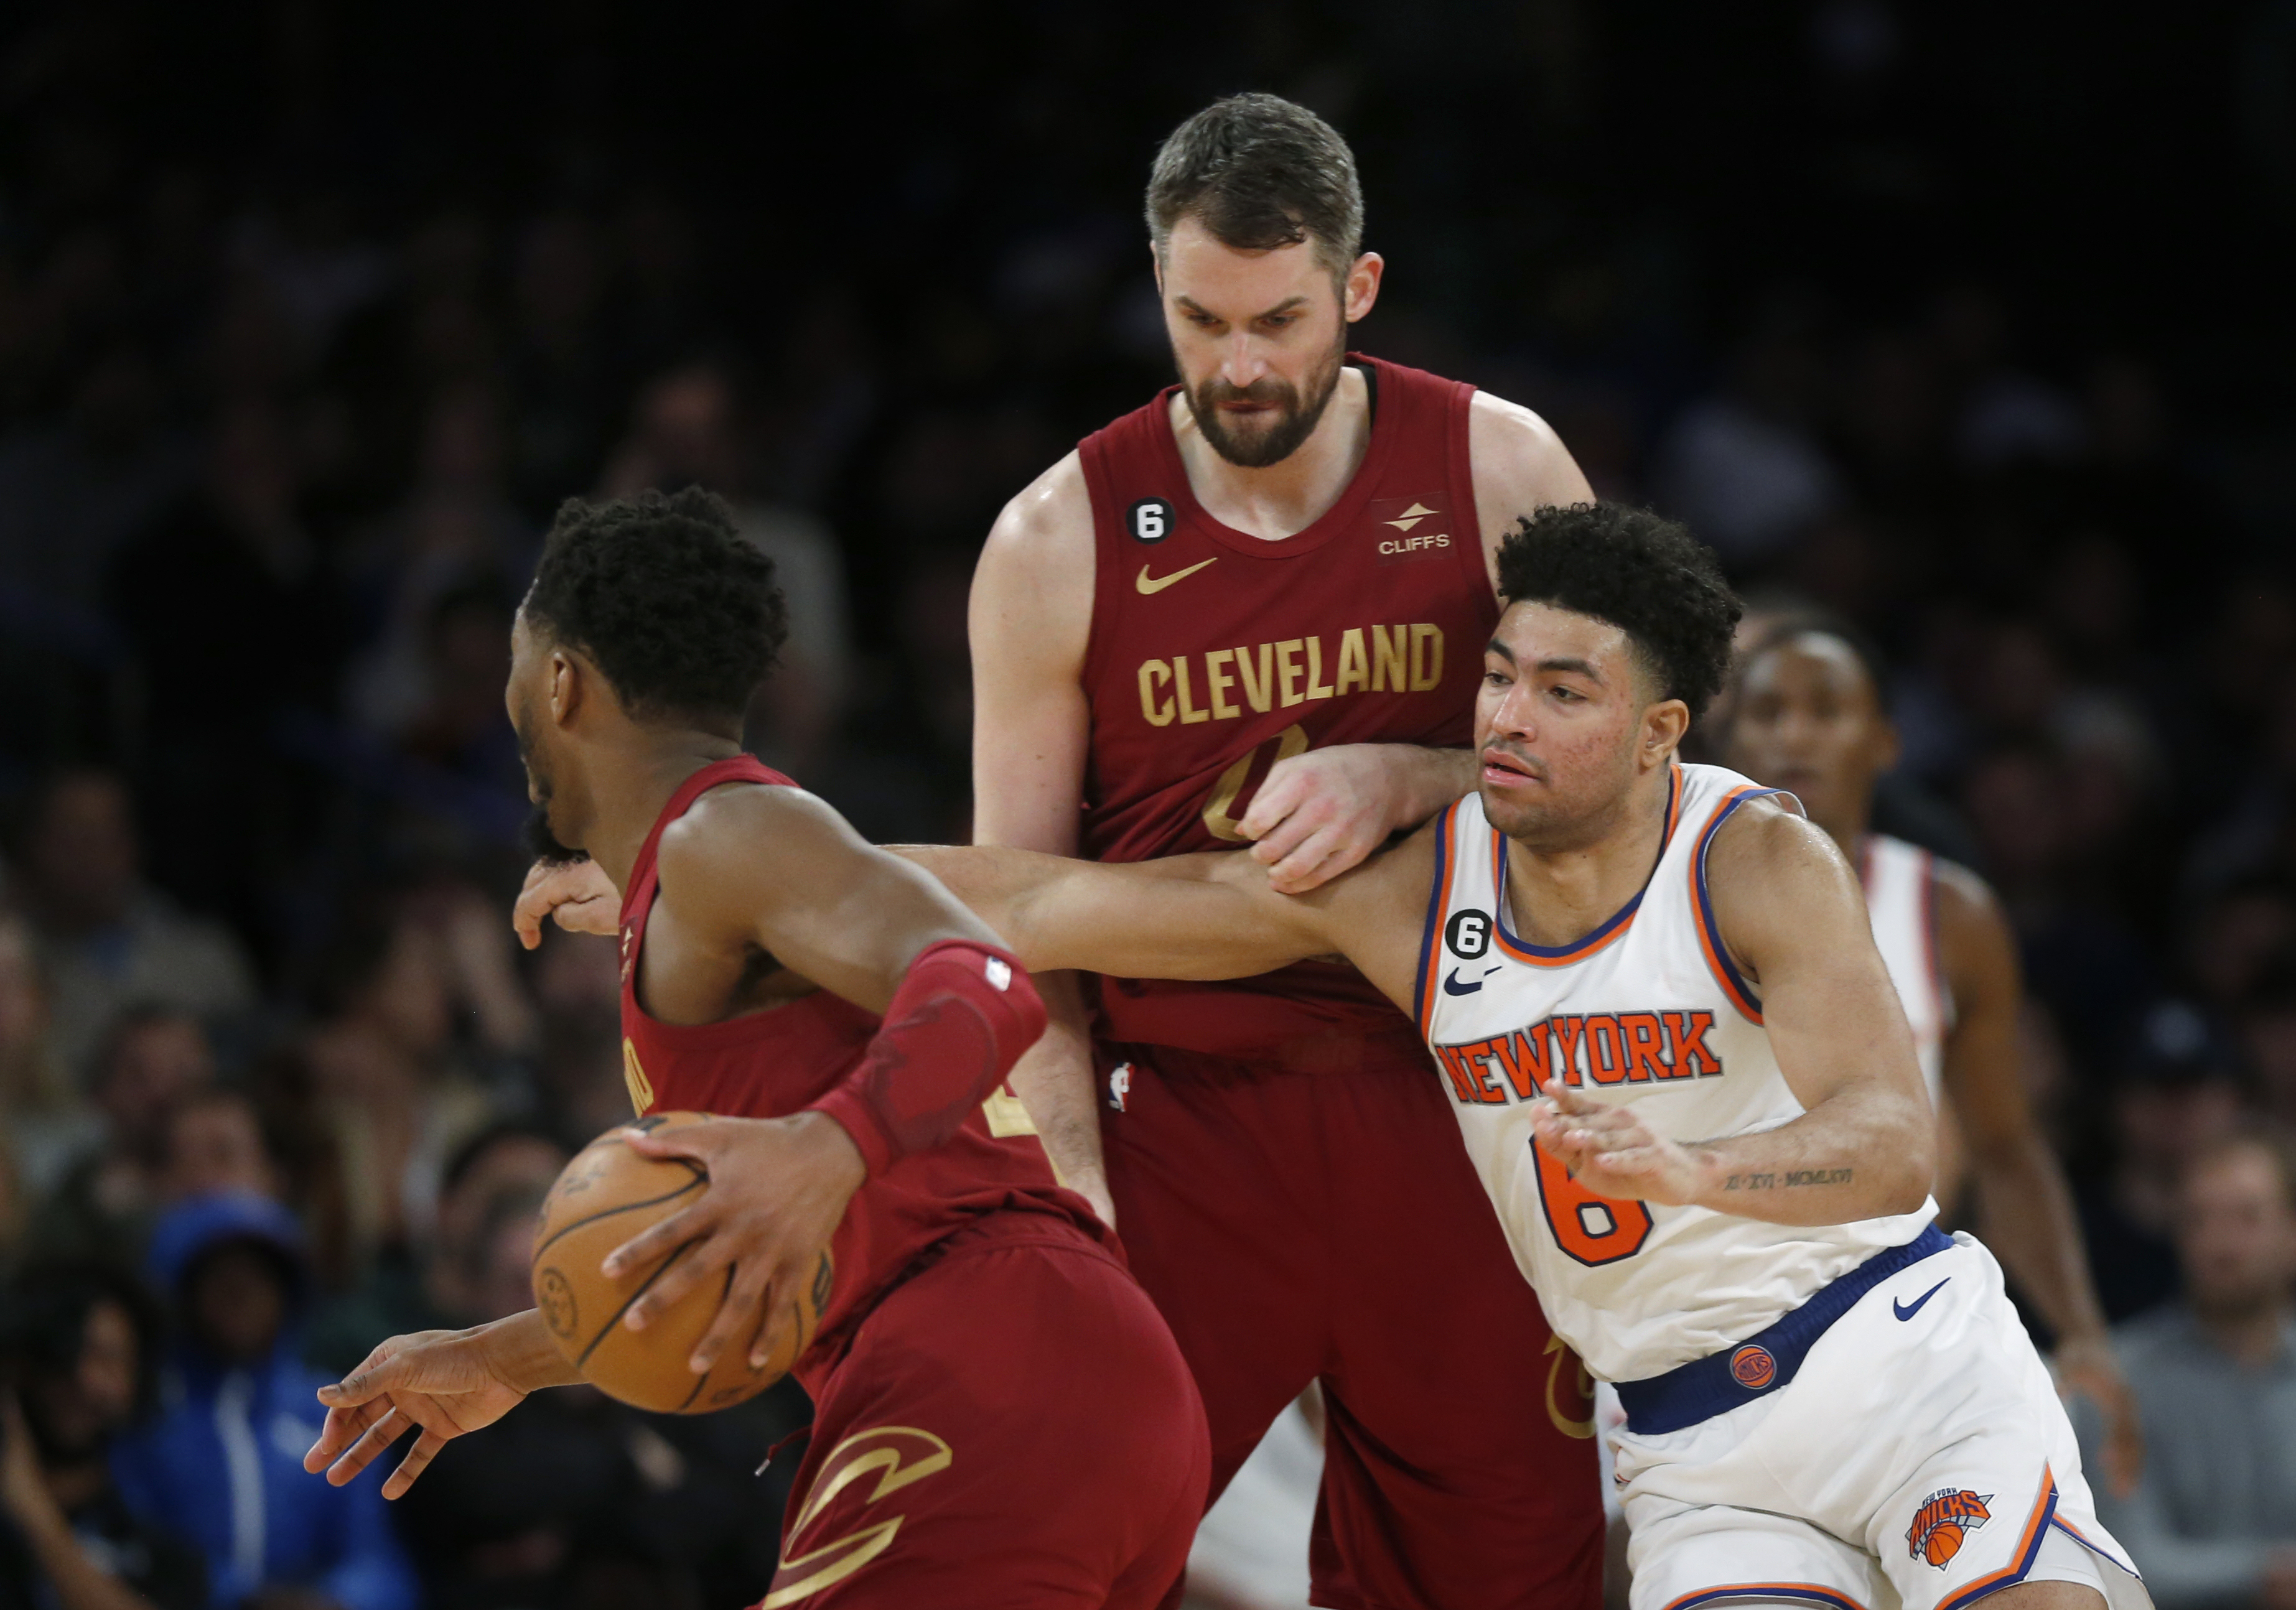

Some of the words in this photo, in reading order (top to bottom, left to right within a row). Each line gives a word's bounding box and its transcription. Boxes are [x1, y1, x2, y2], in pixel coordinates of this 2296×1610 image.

[1137, 504, 1164, 538] 6
[1378, 534, 1450, 555] CLIFFS
[1137, 623, 1444, 727] CLEVELAND
[1456, 916, 1485, 953] 6
[1434, 1020, 1554, 1105] NEW
[1549, 1009, 1724, 1089] YORK
[1529, 1133, 1654, 1267] 6
[1921, 1492, 1936, 1507] NEW
[1937, 1487, 1958, 1498] YORK
[1909, 1490, 1991, 1557] KNICKS
